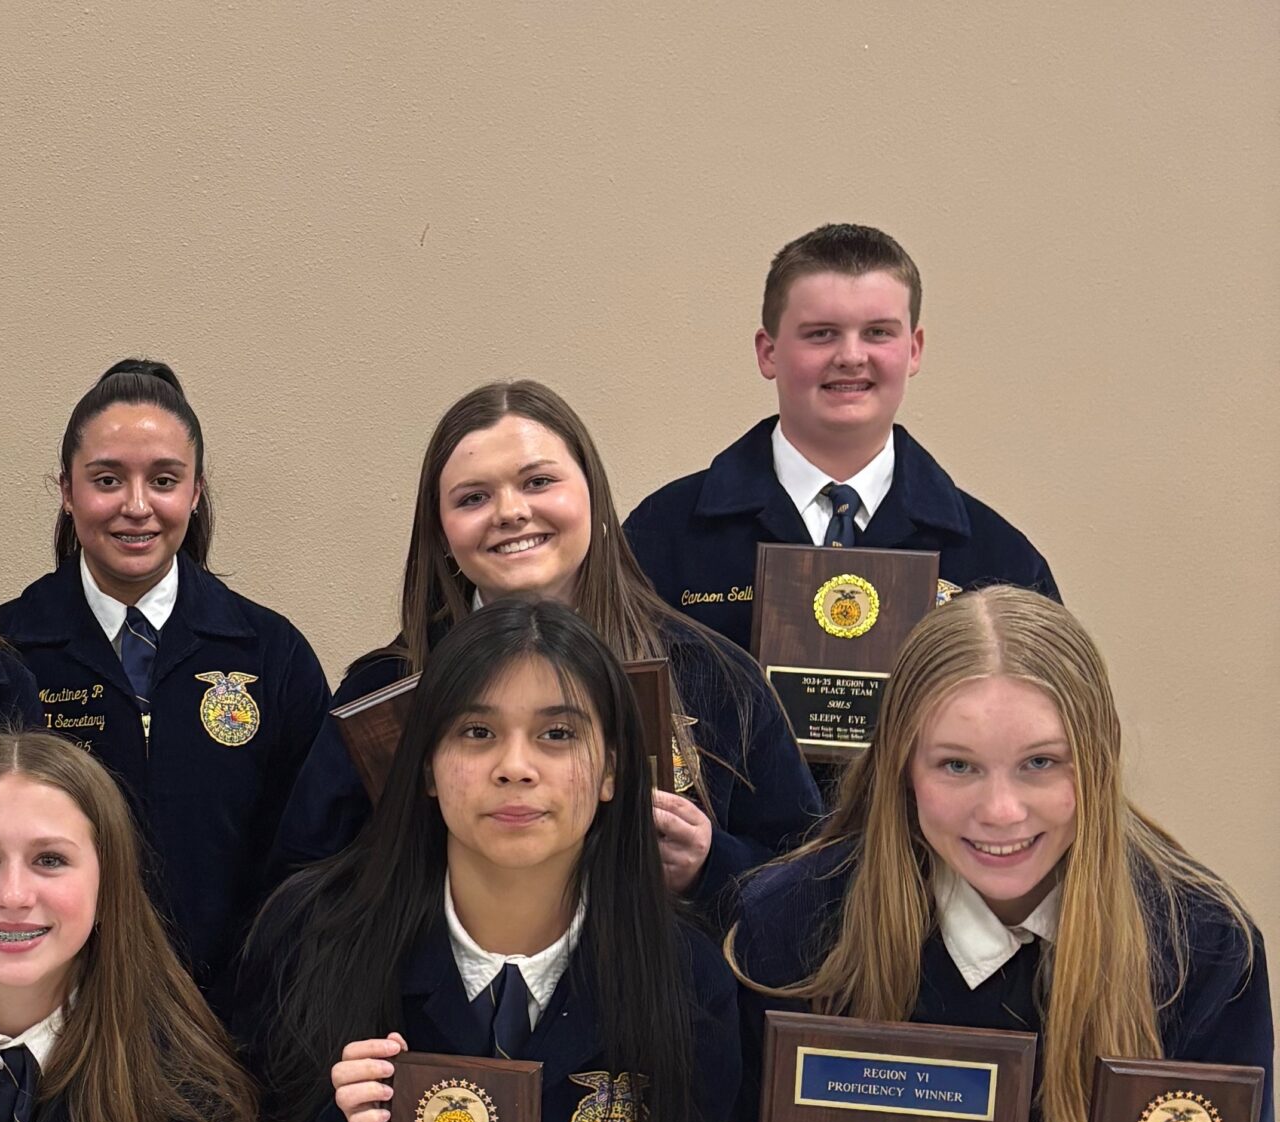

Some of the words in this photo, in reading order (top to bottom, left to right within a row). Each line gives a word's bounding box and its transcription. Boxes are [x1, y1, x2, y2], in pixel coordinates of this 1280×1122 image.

[681, 590, 724, 605] Carson
[836, 679, 864, 687] REGION
[827, 700, 852, 709] SOILS
[55, 713, 105, 731] Secretary
[810, 714, 841, 722] SLEEPY
[849, 716, 866, 724] EYE
[863, 1068, 906, 1080] REGION
[917, 1072, 929, 1083] VI
[828, 1081, 904, 1096] PROFICIENCY
[915, 1089, 962, 1102] WINNER
